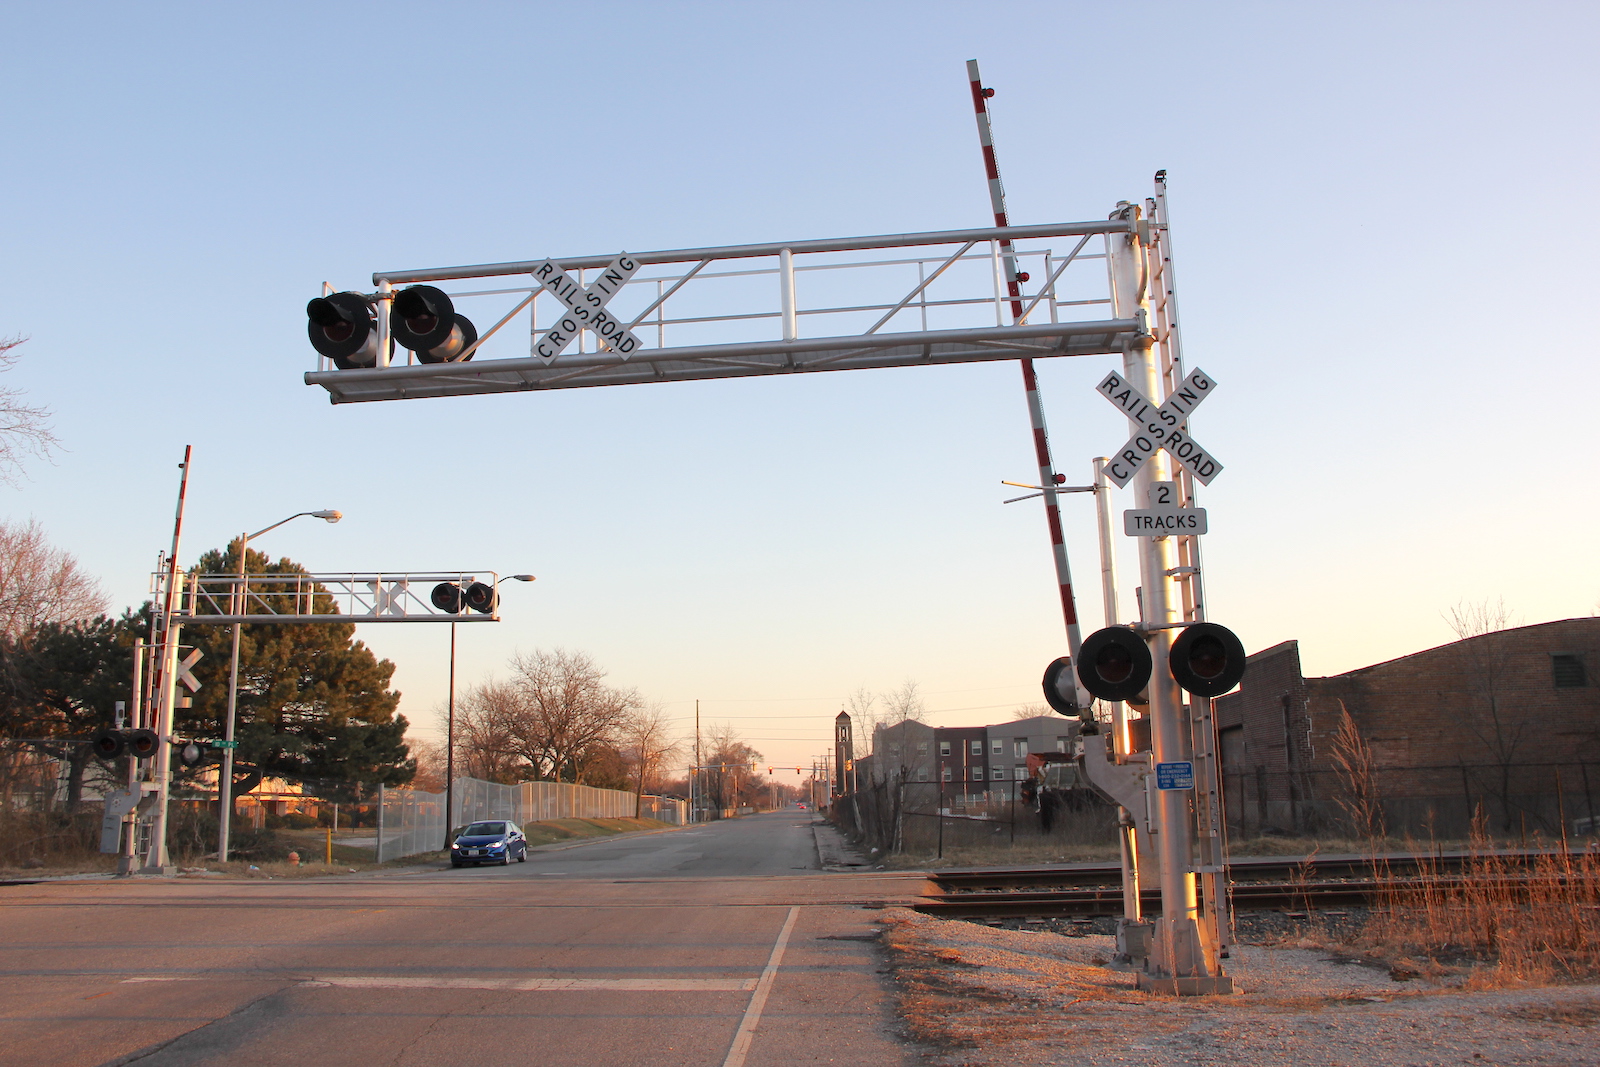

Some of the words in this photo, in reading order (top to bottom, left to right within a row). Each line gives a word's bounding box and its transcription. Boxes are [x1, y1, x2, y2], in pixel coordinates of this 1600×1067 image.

[538, 257, 634, 358] CROSSING
[1111, 375, 1209, 480] CROSSING
[1134, 515, 1197, 529] TRACKS
[1157, 486, 1170, 504] 2
